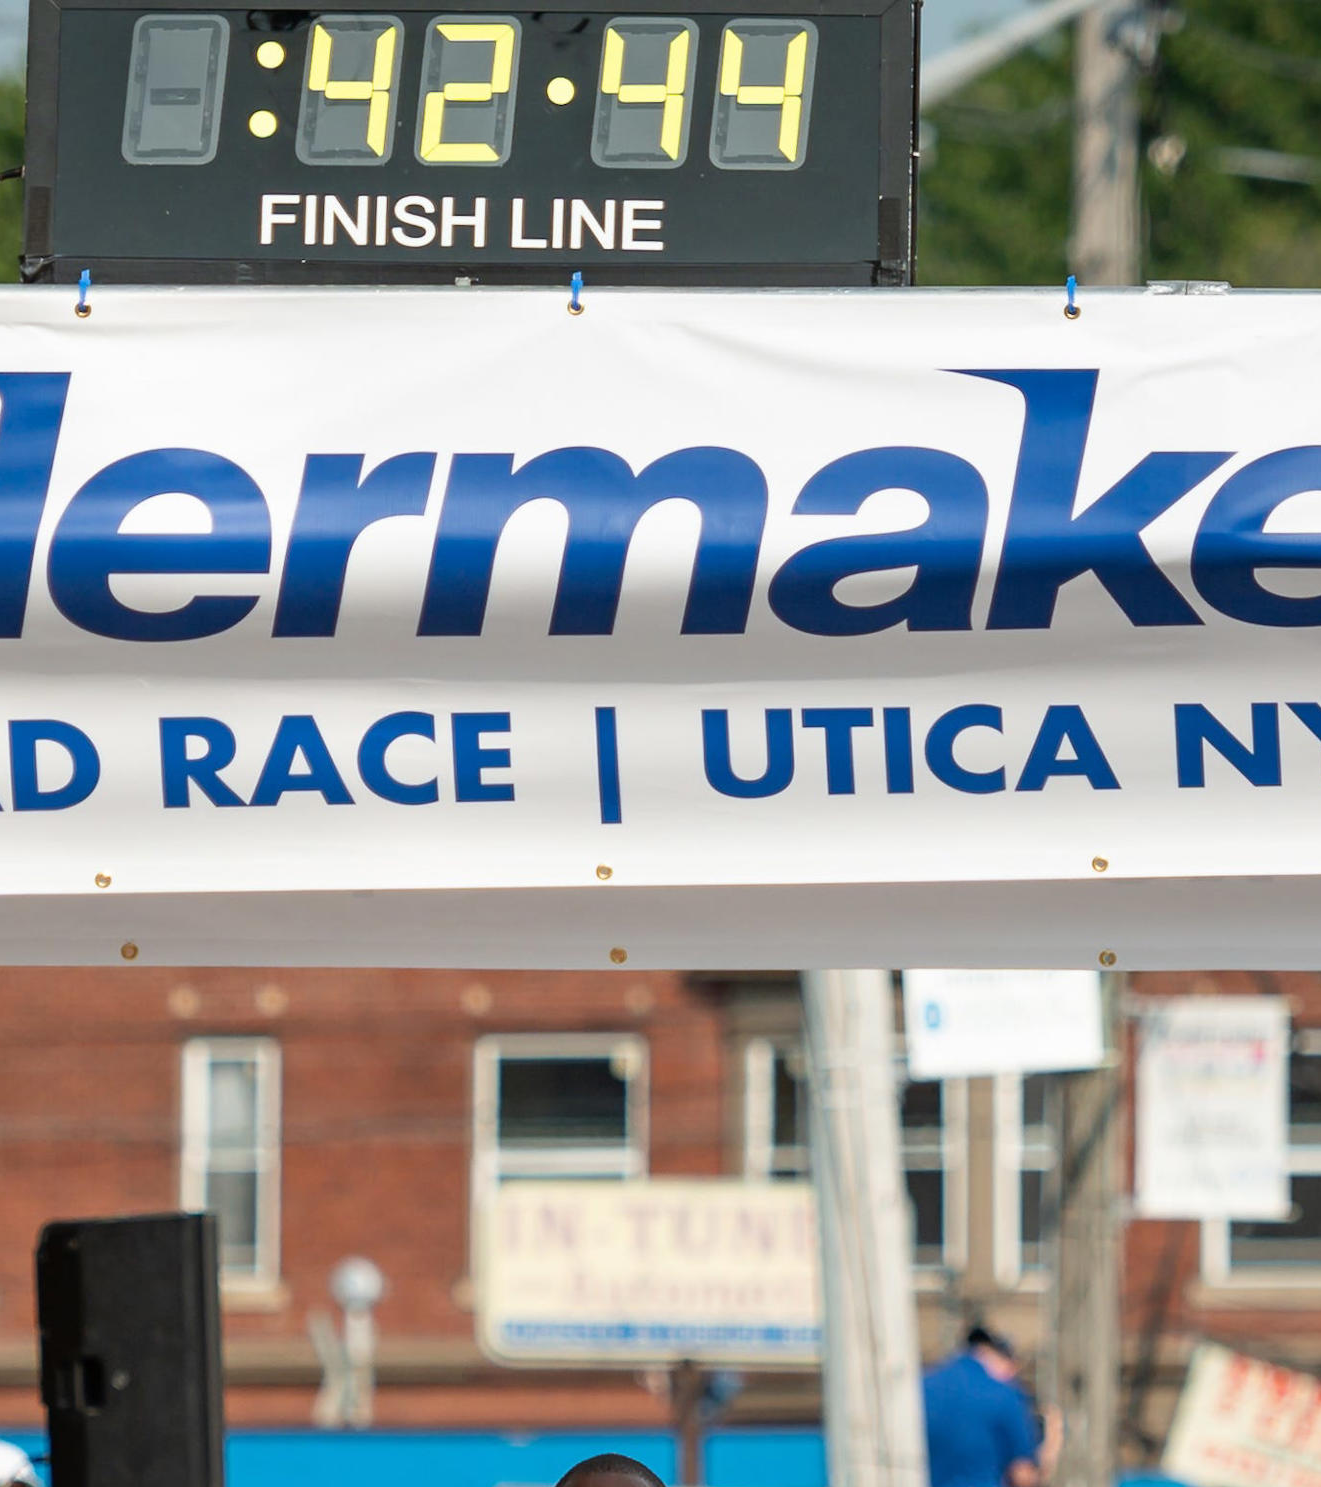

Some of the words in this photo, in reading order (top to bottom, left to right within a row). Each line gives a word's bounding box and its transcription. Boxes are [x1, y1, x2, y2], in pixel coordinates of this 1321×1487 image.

[260, 194, 487, 249] FINISH
[511, 197, 665, 252] LINE
[159, 710, 516, 808] RACE
[701, 703, 1121, 800] UTICA
